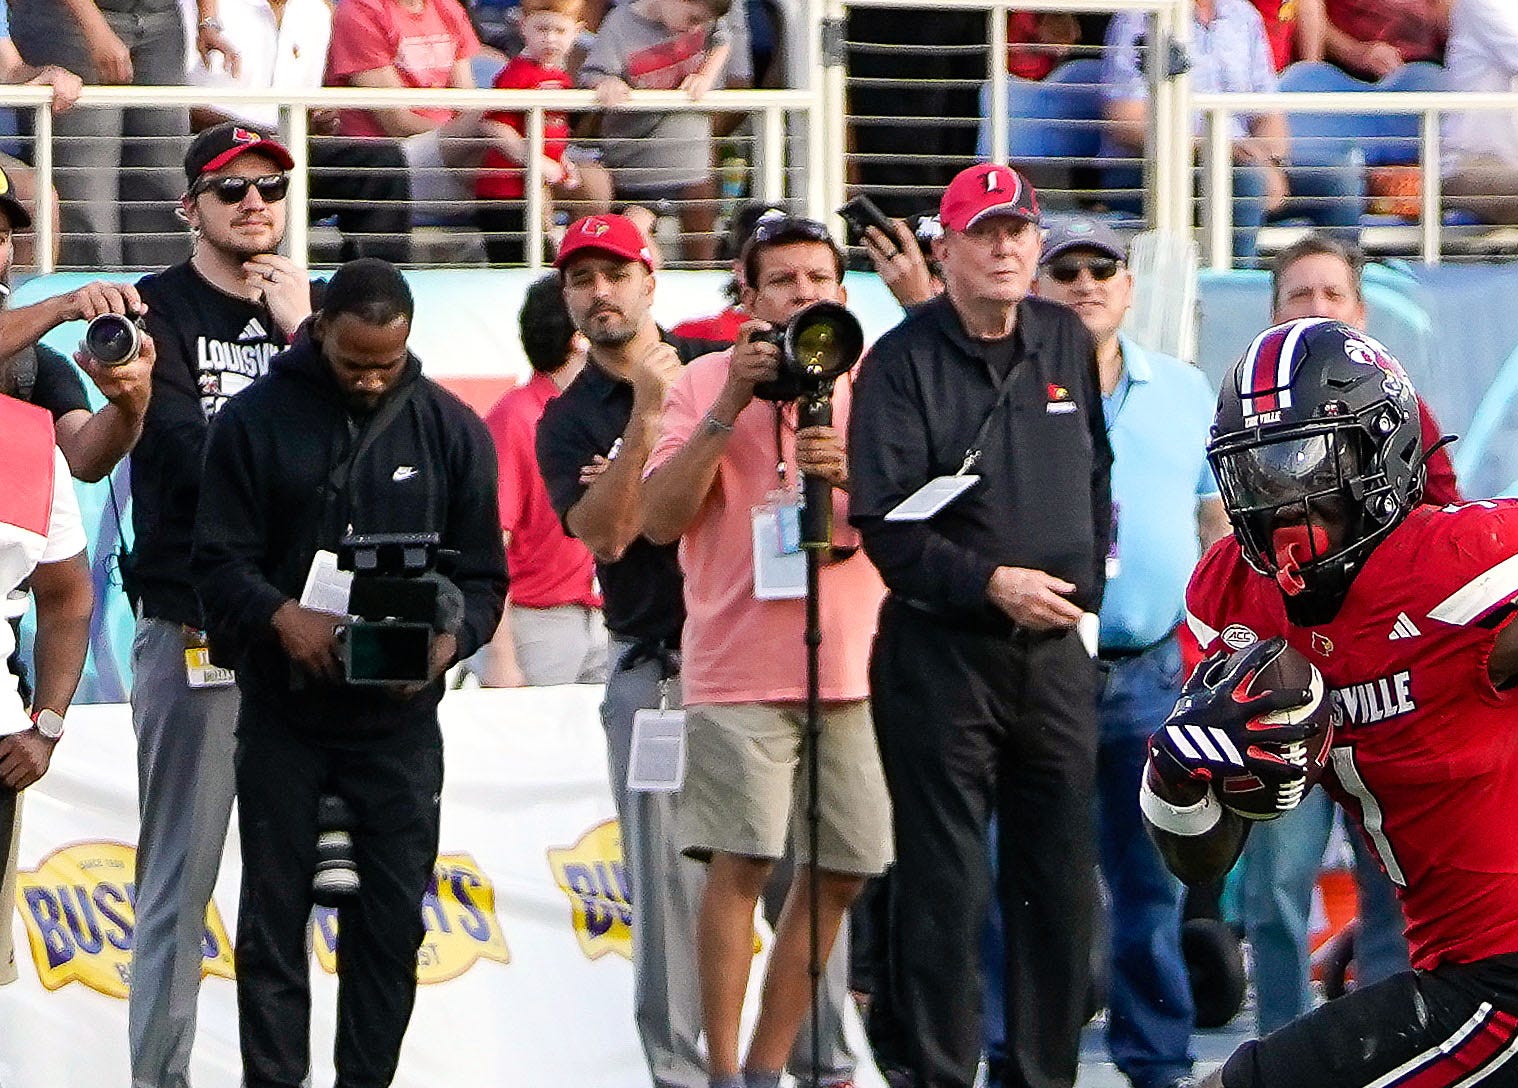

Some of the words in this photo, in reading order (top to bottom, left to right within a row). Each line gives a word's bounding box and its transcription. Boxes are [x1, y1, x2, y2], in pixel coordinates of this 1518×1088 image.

[1226, 631, 1251, 642] ACC
[1330, 670, 1416, 727] SVILLE
[1329, 745, 1407, 887] 1
